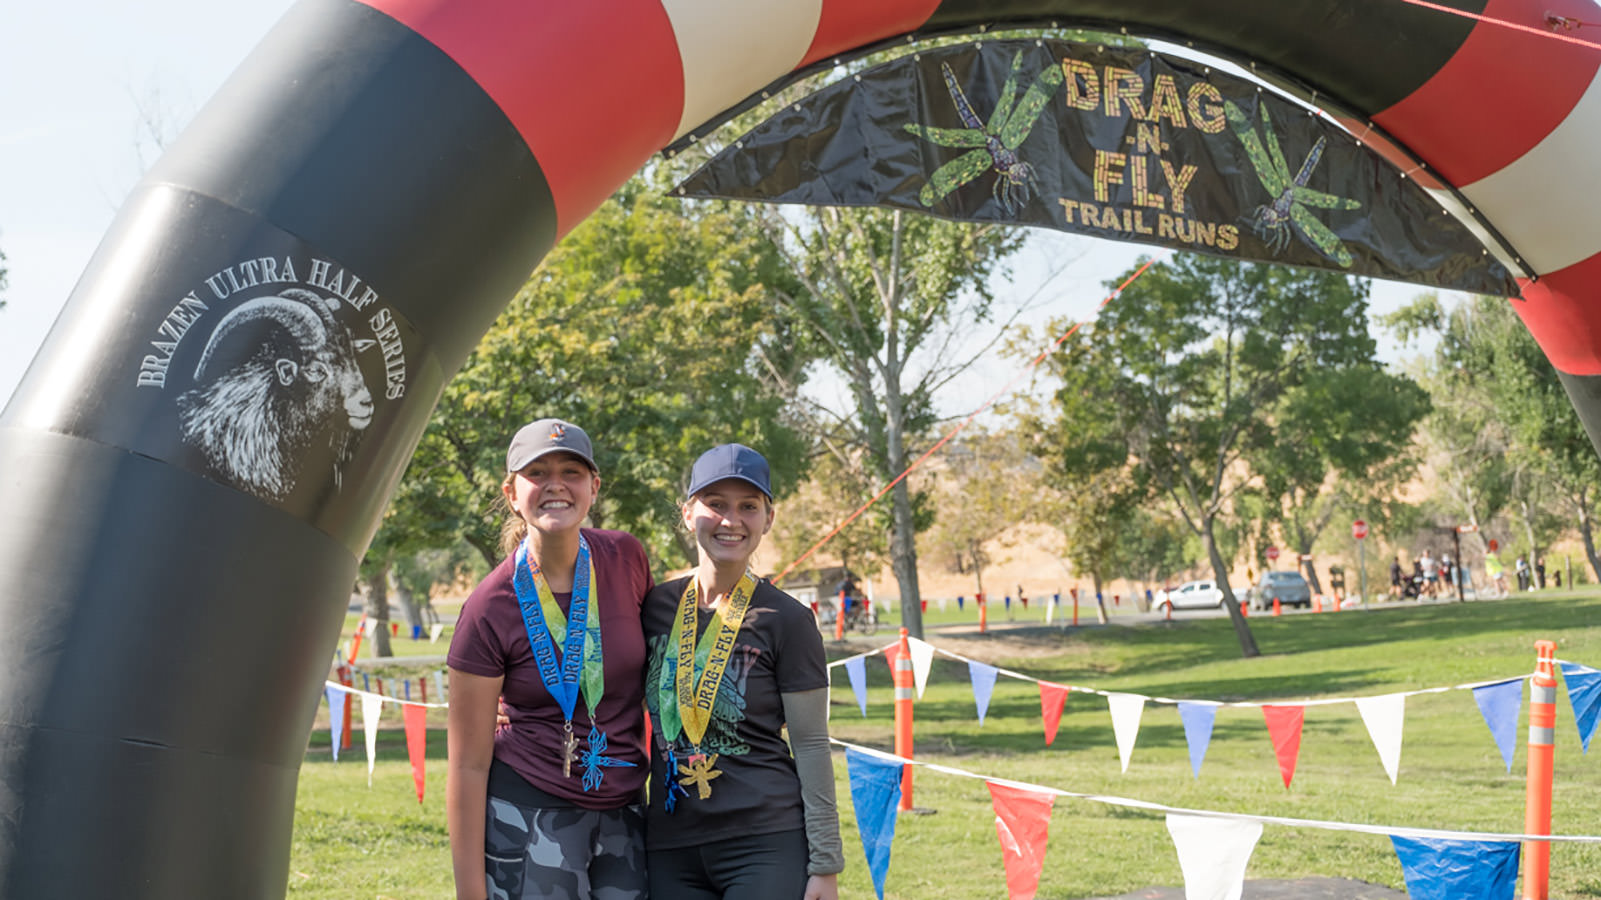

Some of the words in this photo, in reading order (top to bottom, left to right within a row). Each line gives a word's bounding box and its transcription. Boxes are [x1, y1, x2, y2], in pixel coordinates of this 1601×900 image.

[1062, 57, 1226, 134] DRAG
[1093, 149, 1198, 213] FLY
[1058, 197, 1153, 235] TRAIL
[1158, 213, 1239, 250] RUNS
[137, 291, 209, 389] BRAZEN
[205, 256, 298, 300] ULTRA
[306, 258, 378, 312] HALF
[369, 307, 406, 400] SERIES
[522, 601, 559, 686] DRAG-N-FLY
[563, 596, 587, 684] DRAG-N-FLY
[680, 589, 696, 668] DRAG-N-FLY
[697, 625, 736, 711] DRAG-N-FLY
